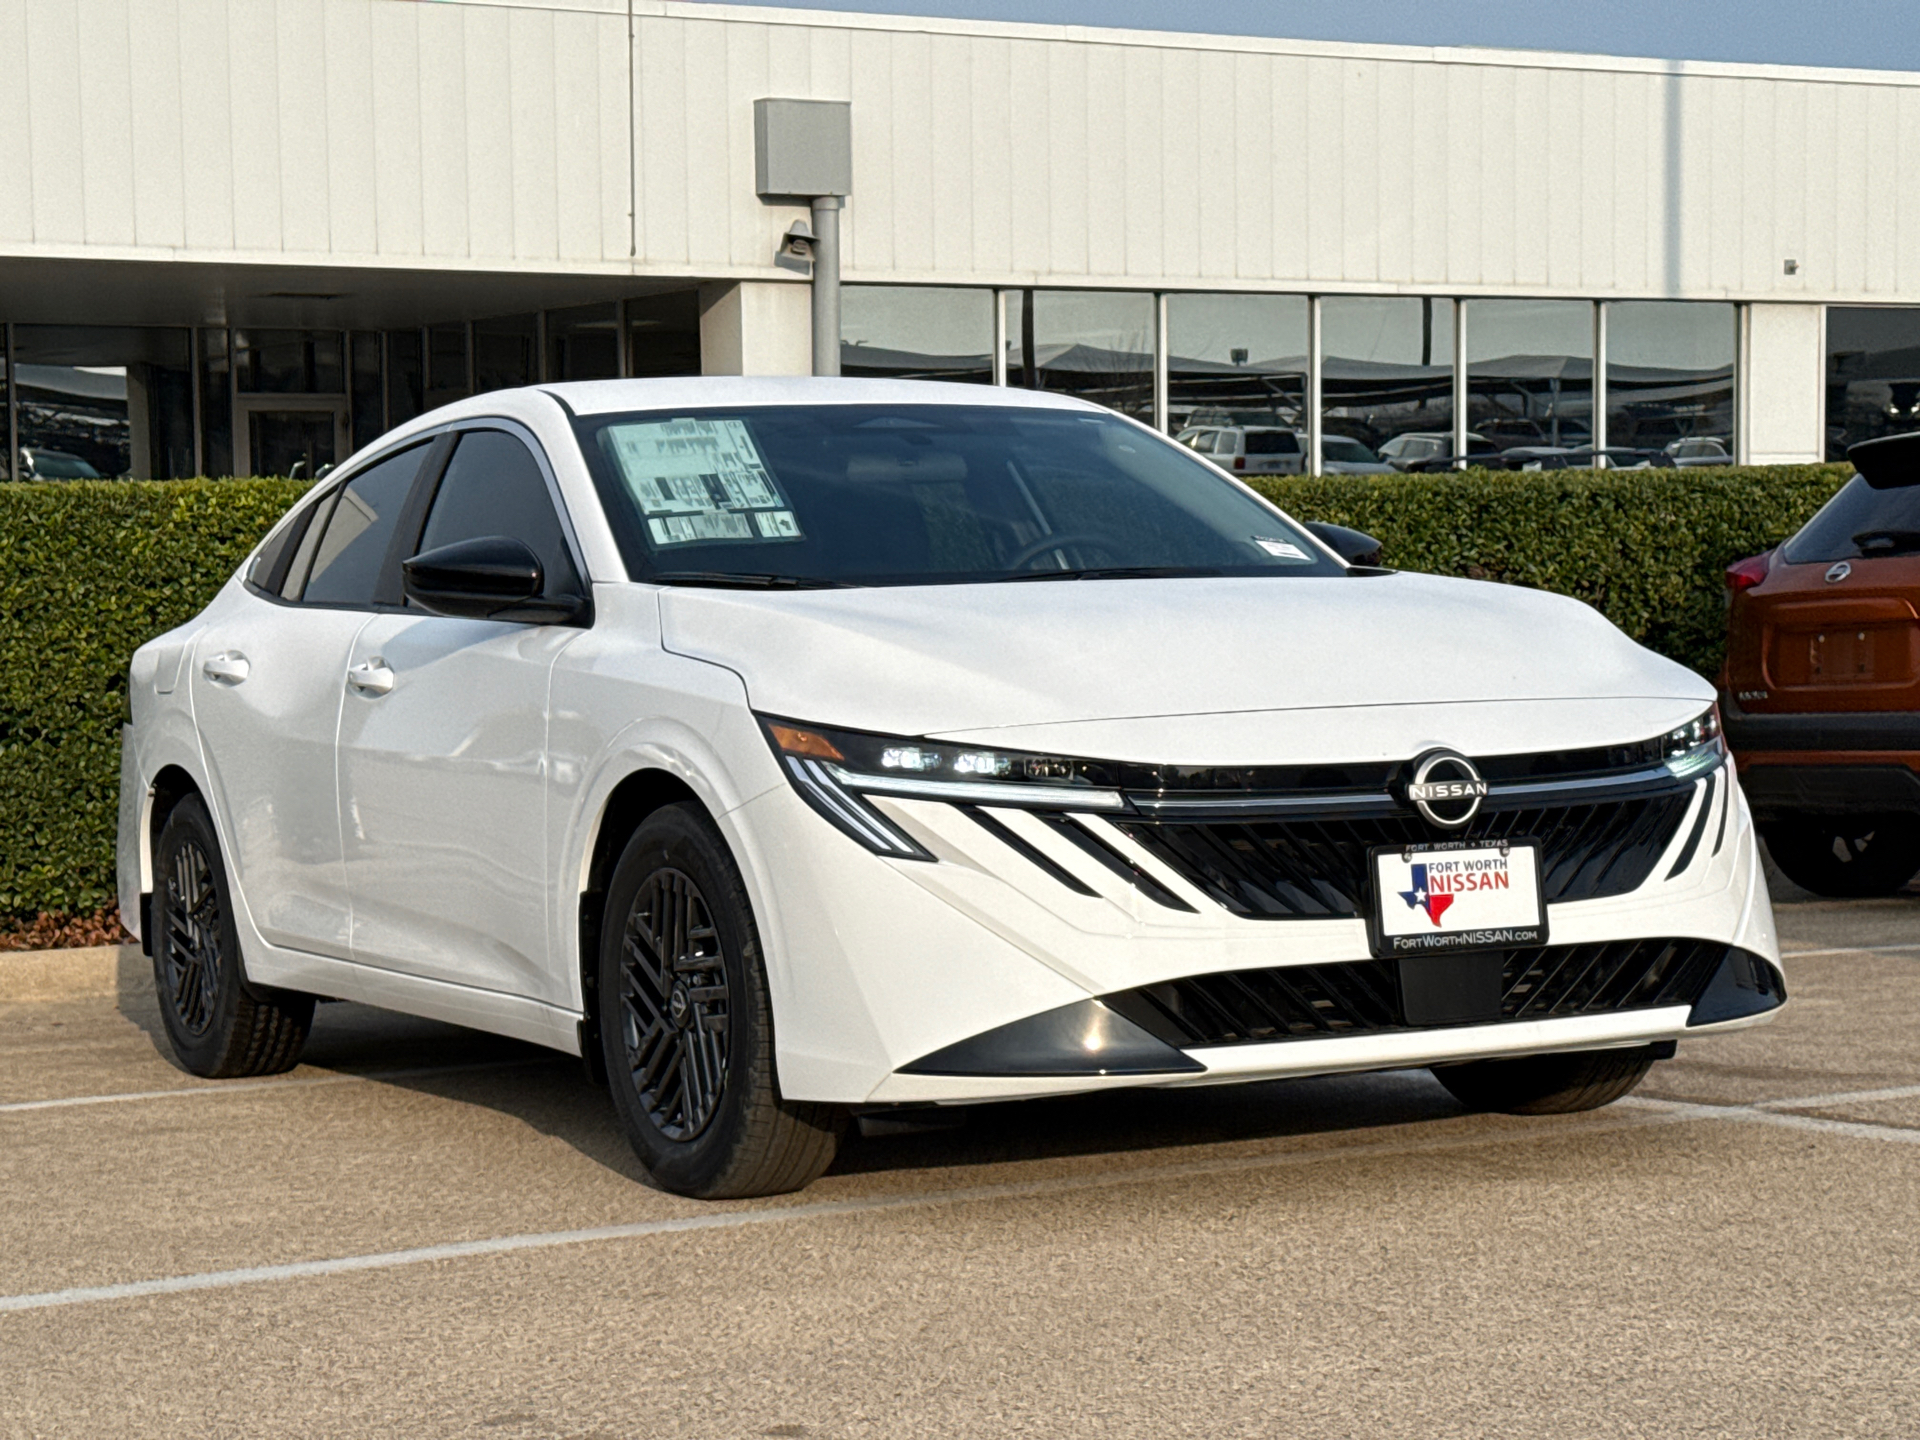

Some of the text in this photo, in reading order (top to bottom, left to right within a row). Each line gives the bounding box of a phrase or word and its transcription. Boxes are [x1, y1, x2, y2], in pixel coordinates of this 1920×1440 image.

[1411, 782, 1487, 799] NISSAN
[1405, 839, 1508, 852] FORT WORTH TEXAS
[1428, 858, 1508, 873] FORT WORTH
[1429, 870, 1509, 893] NISSAN
